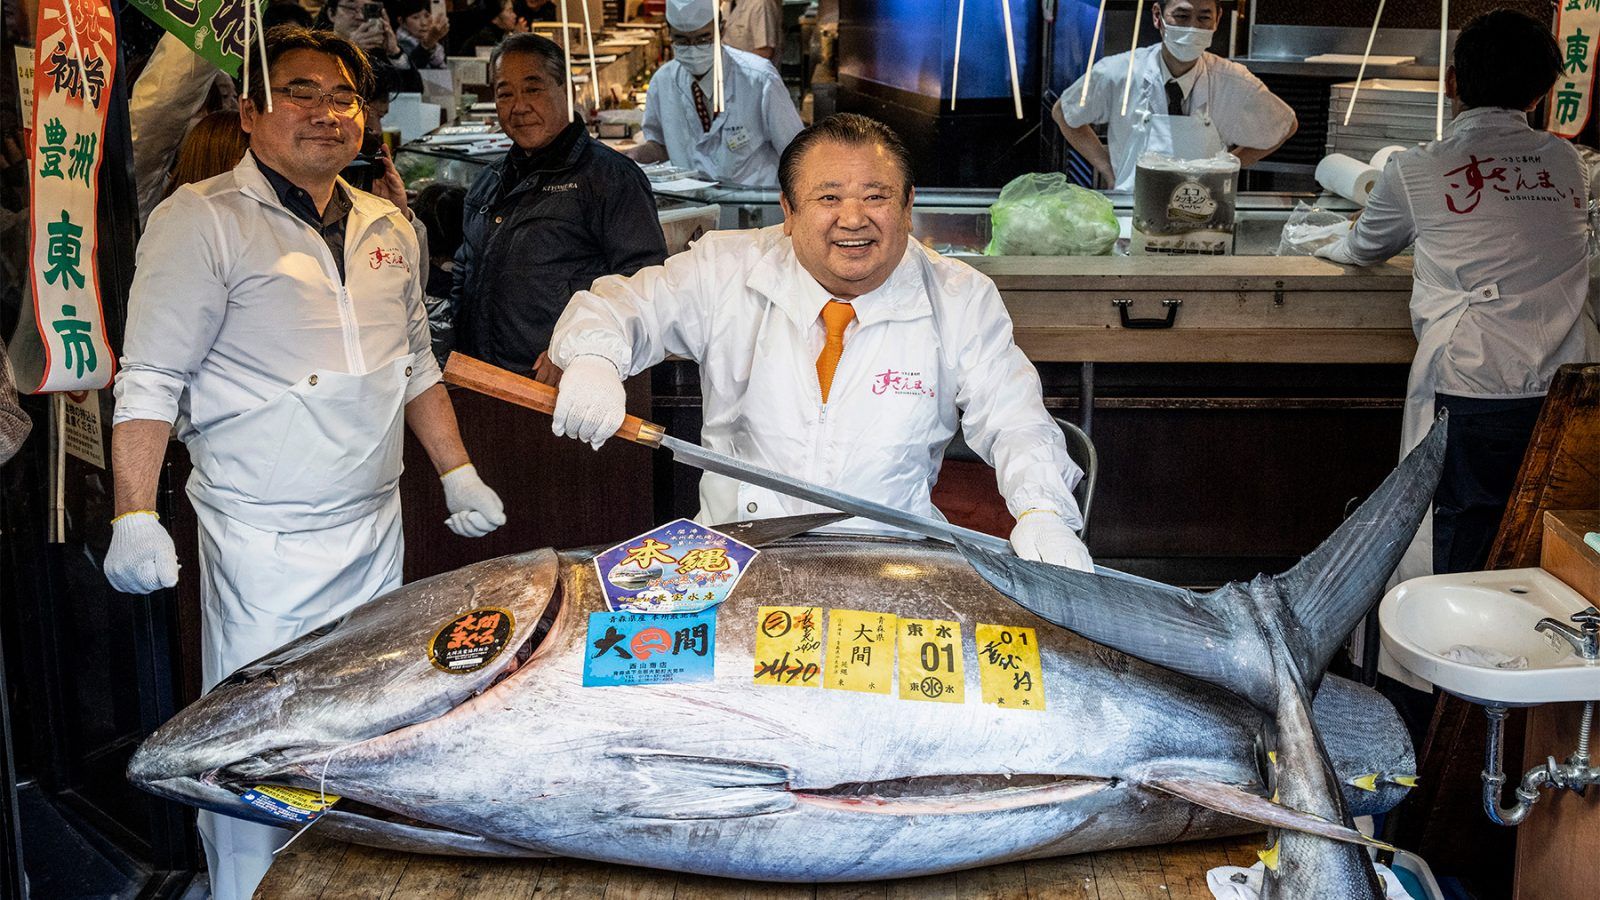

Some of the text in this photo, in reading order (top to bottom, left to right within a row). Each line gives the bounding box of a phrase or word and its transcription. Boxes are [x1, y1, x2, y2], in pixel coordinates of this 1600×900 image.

[45, 41, 105, 110] 初荷
[39, 117, 98, 188] 豊洲
[1174, 194, 1207, 204] クッキング
[1184, 187, 1200, 196] エコ
[620, 538, 732, 575] 本縄
[851, 624, 875, 667] 大間
[1000, 631, 1028, 646] 01
[920, 642, 955, 673] 01
